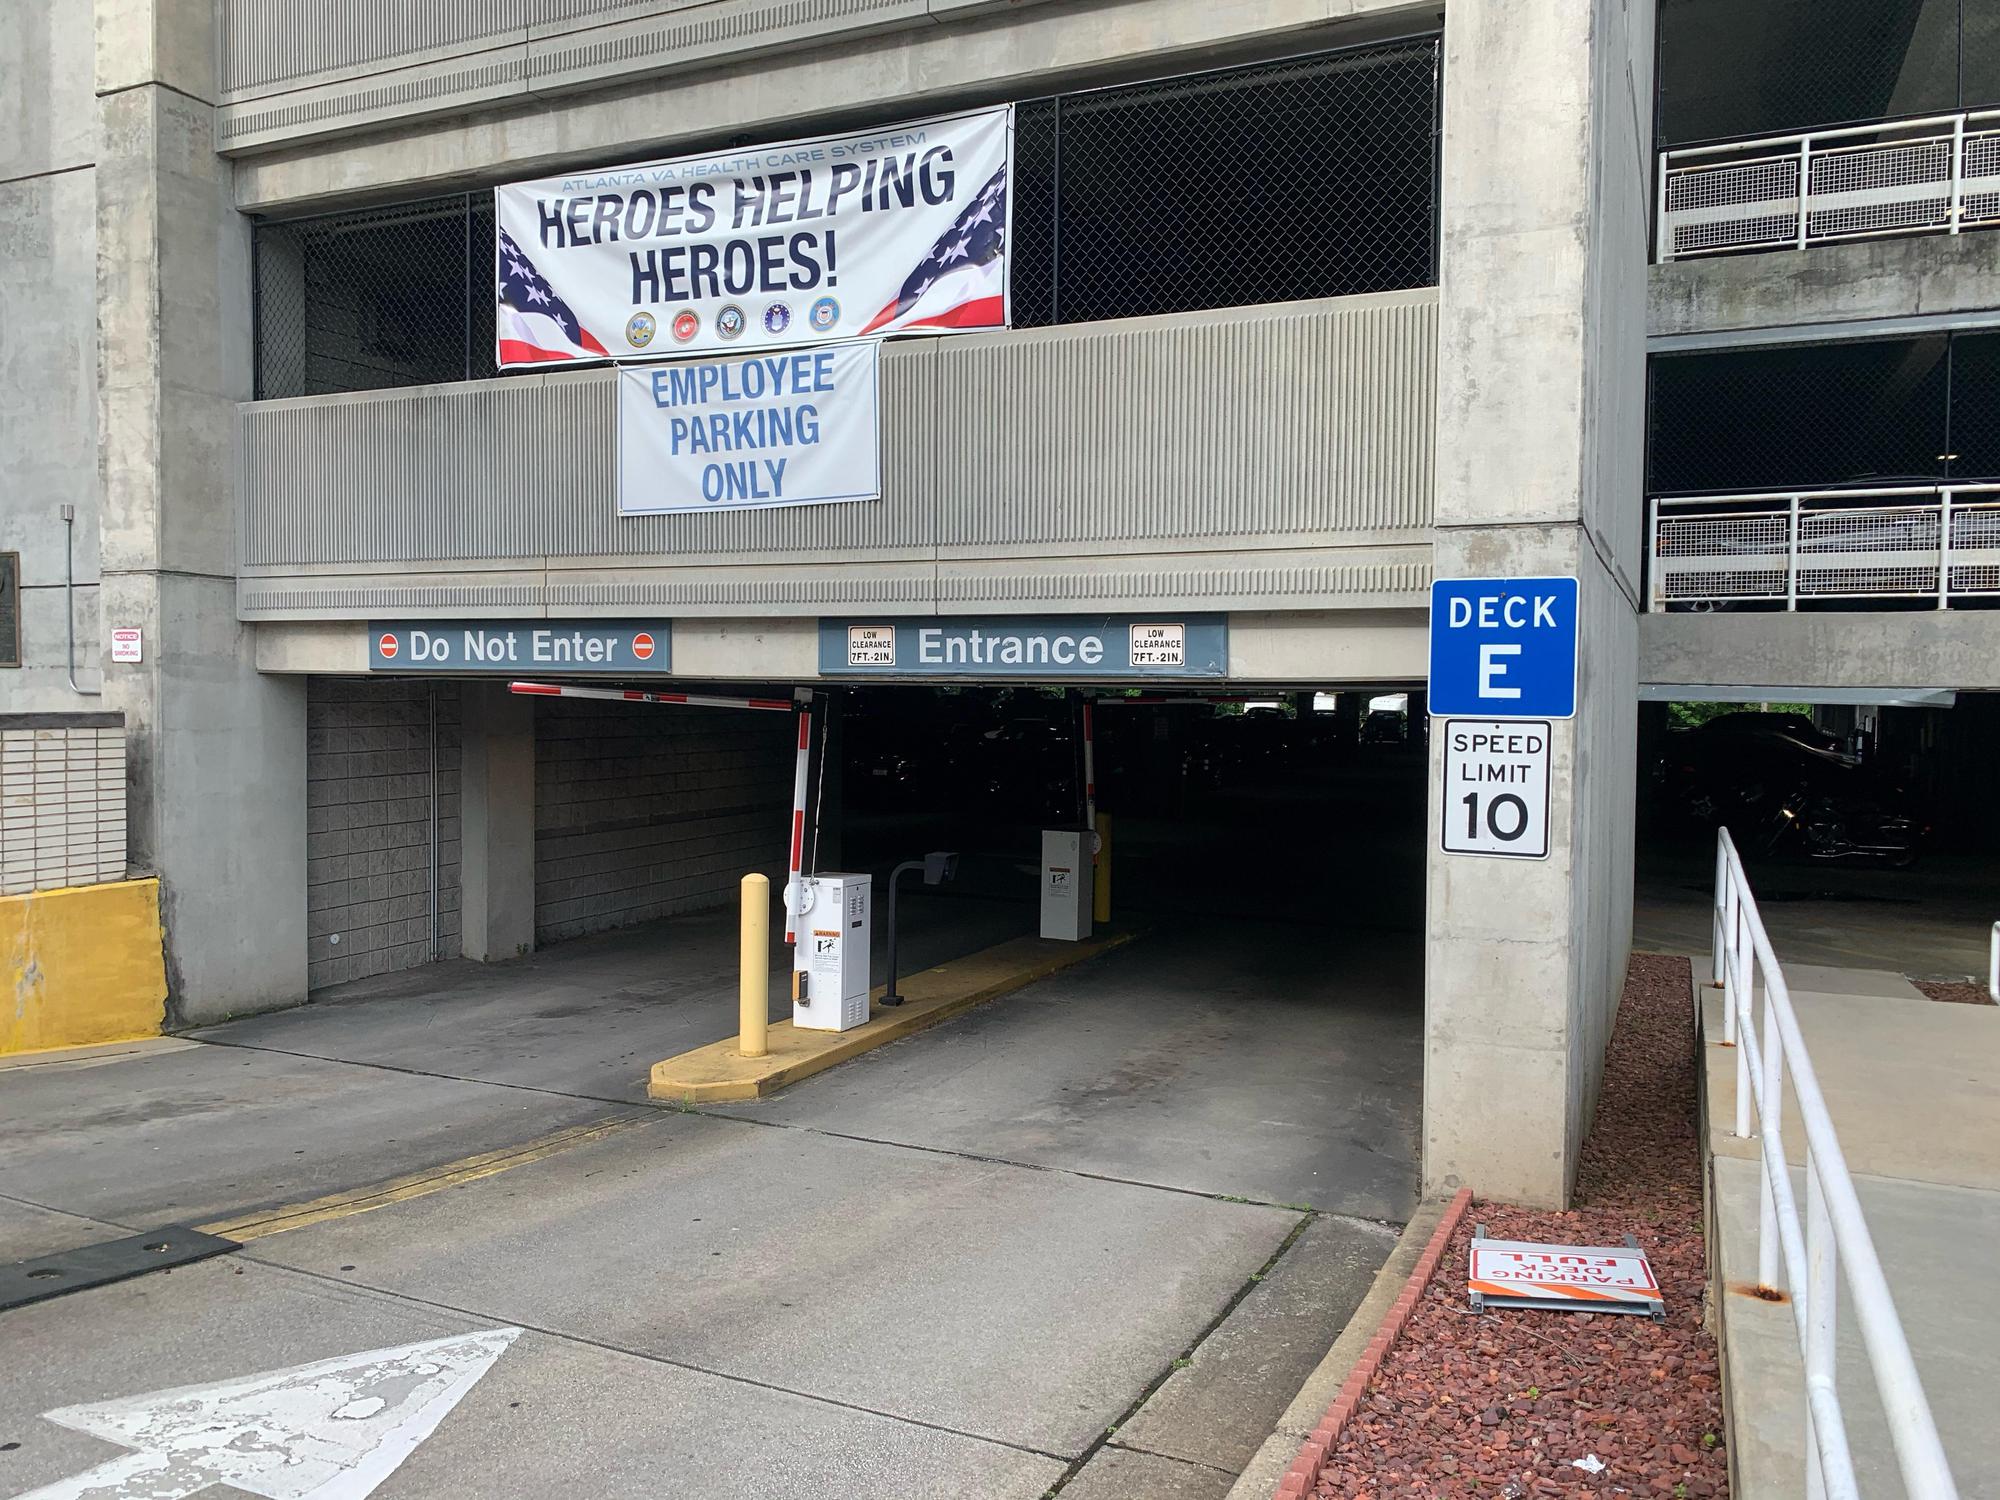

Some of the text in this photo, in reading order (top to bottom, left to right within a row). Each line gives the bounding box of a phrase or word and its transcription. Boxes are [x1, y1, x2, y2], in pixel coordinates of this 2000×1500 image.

[562, 132, 927, 192] ATLANTA VA HEALTH CARE SYSTEM
[537, 145, 955, 249] HEROES HELPING
[629, 229, 838, 305] HEROES!
[652, 353, 835, 409] EMPLOYEE
[670, 404, 820, 455] PARKING
[701, 458, 788, 501] ONLY
[1449, 595, 1557, 628] DECK
[410, 630, 618, 662] Do Not Enter
[852, 640, 891, 648] CLEARANCE
[863, 631, 877, 639] LOW
[919, 628, 1104, 665] Entrance
[1134, 640, 1181, 648] CLEARANCE
[1148, 629, 1164, 638] LOW
[1478, 644, 1522, 699] E
[1453, 734, 1543, 754] SPEED
[1462, 763, 1531, 783] LIMIT
[1462, 792, 1529, 841] 10
[1500, 1253, 1617, 1267] FULL
[1520, 1263, 1603, 1275] DECK
[1492, 1270, 1635, 1285] PARKING
